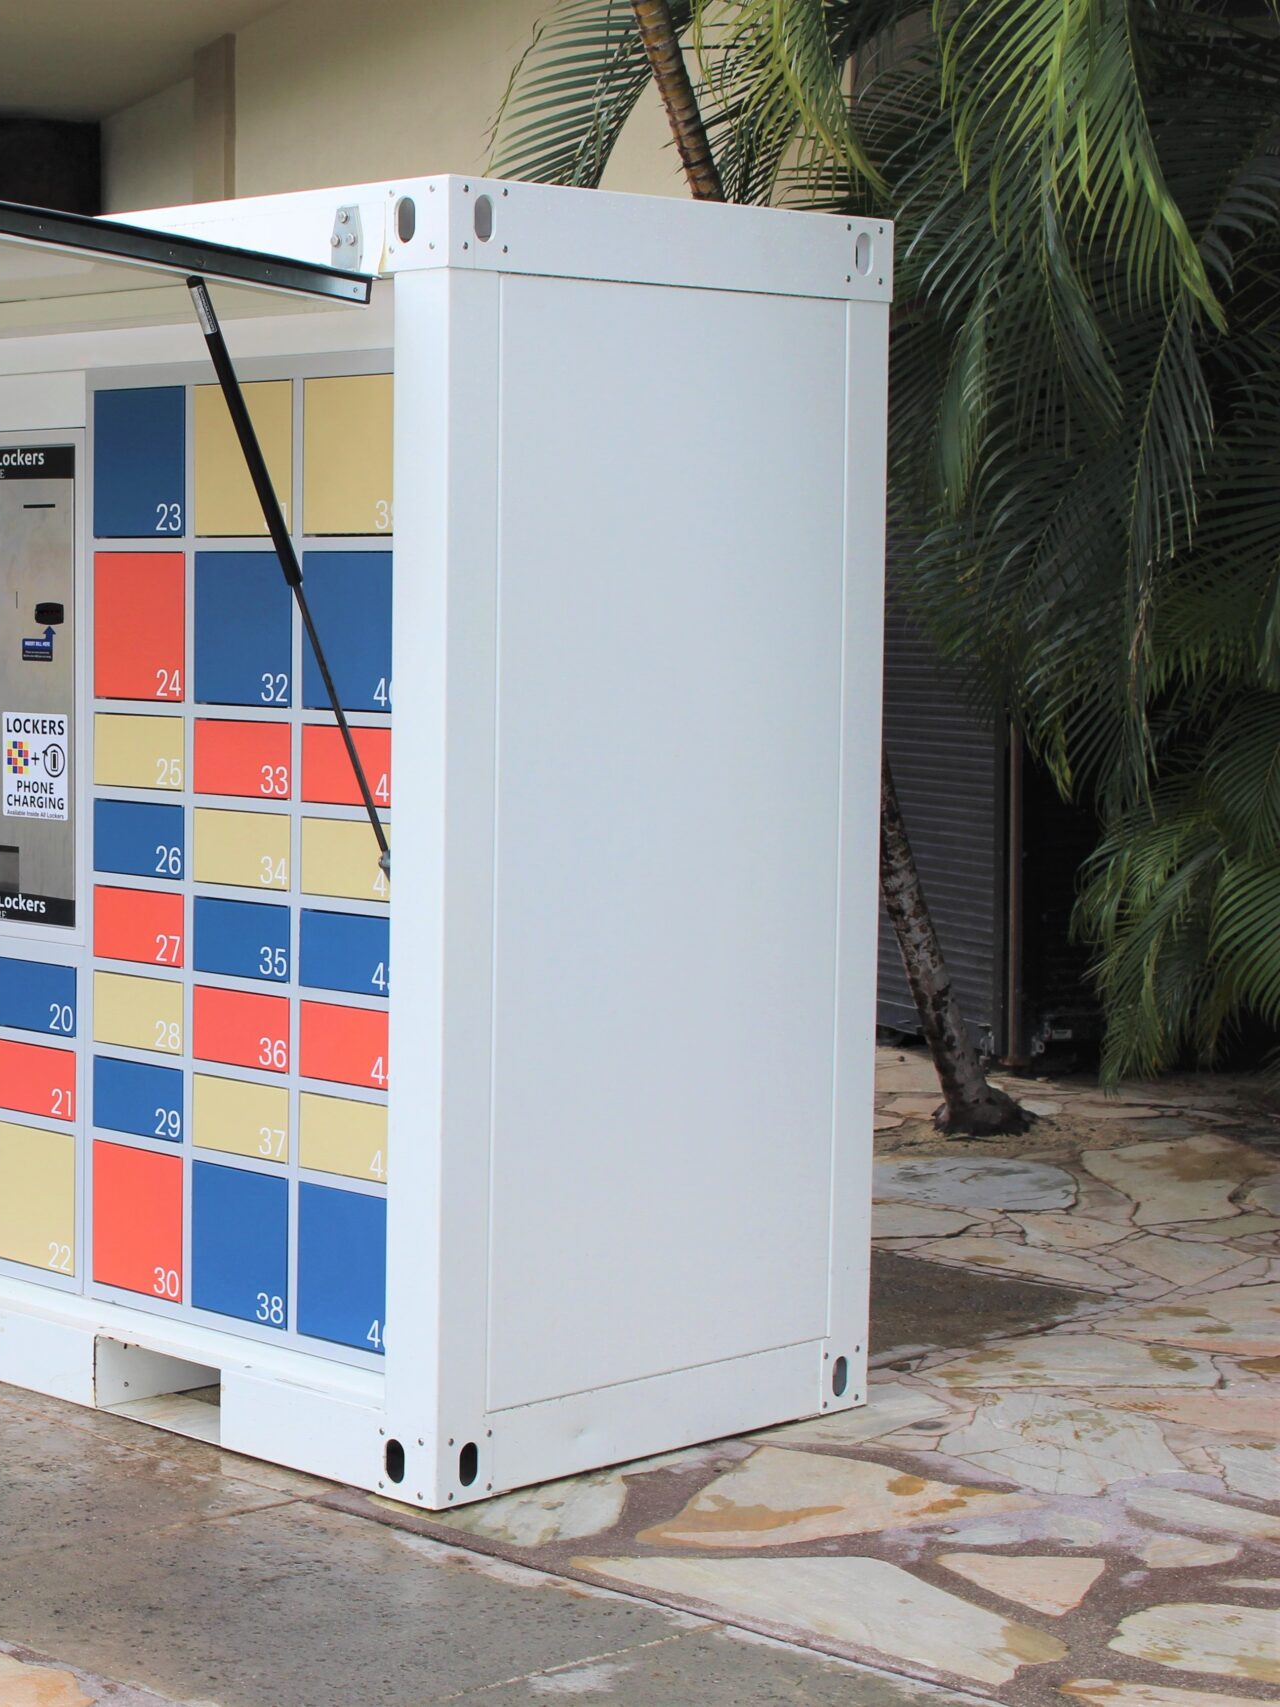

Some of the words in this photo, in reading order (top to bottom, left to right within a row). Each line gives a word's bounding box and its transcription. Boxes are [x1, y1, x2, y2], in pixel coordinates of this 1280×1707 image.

[155, 503, 182, 531] 23
[375, 499, 393, 529] 3
[155, 669, 182, 697] 24
[260, 673, 288, 702] 32
[373, 677, 392, 707] 4
[6, 718, 65, 736] LOCKERS
[156, 758, 182, 786] 25
[260, 765, 288, 795] 33
[7, 794, 65, 810] CHARGING
[16, 780, 54, 795] PHONE
[375, 773, 390, 803] 4
[155, 845, 182, 875] 26
[260, 856, 287, 885] 34
[373, 868, 387, 897] 4
[155, 934, 181, 963] 27
[259, 946, 287, 977] 35
[371, 962, 389, 991] 4
[49, 1003, 73, 1032] 20
[154, 1020, 180, 1049] 28
[258, 1037, 287, 1068] 36
[370, 1056, 388, 1085] 4
[50, 1088, 72, 1117] 21
[154, 1108, 180, 1138] 29
[259, 1127, 286, 1158] 37
[369, 1150, 387, 1179] 4
[47, 1242, 71, 1271] 22
[153, 1266, 179, 1297] 30
[256, 1292, 284, 1324] 38
[366, 1319, 386, 1348] 4
